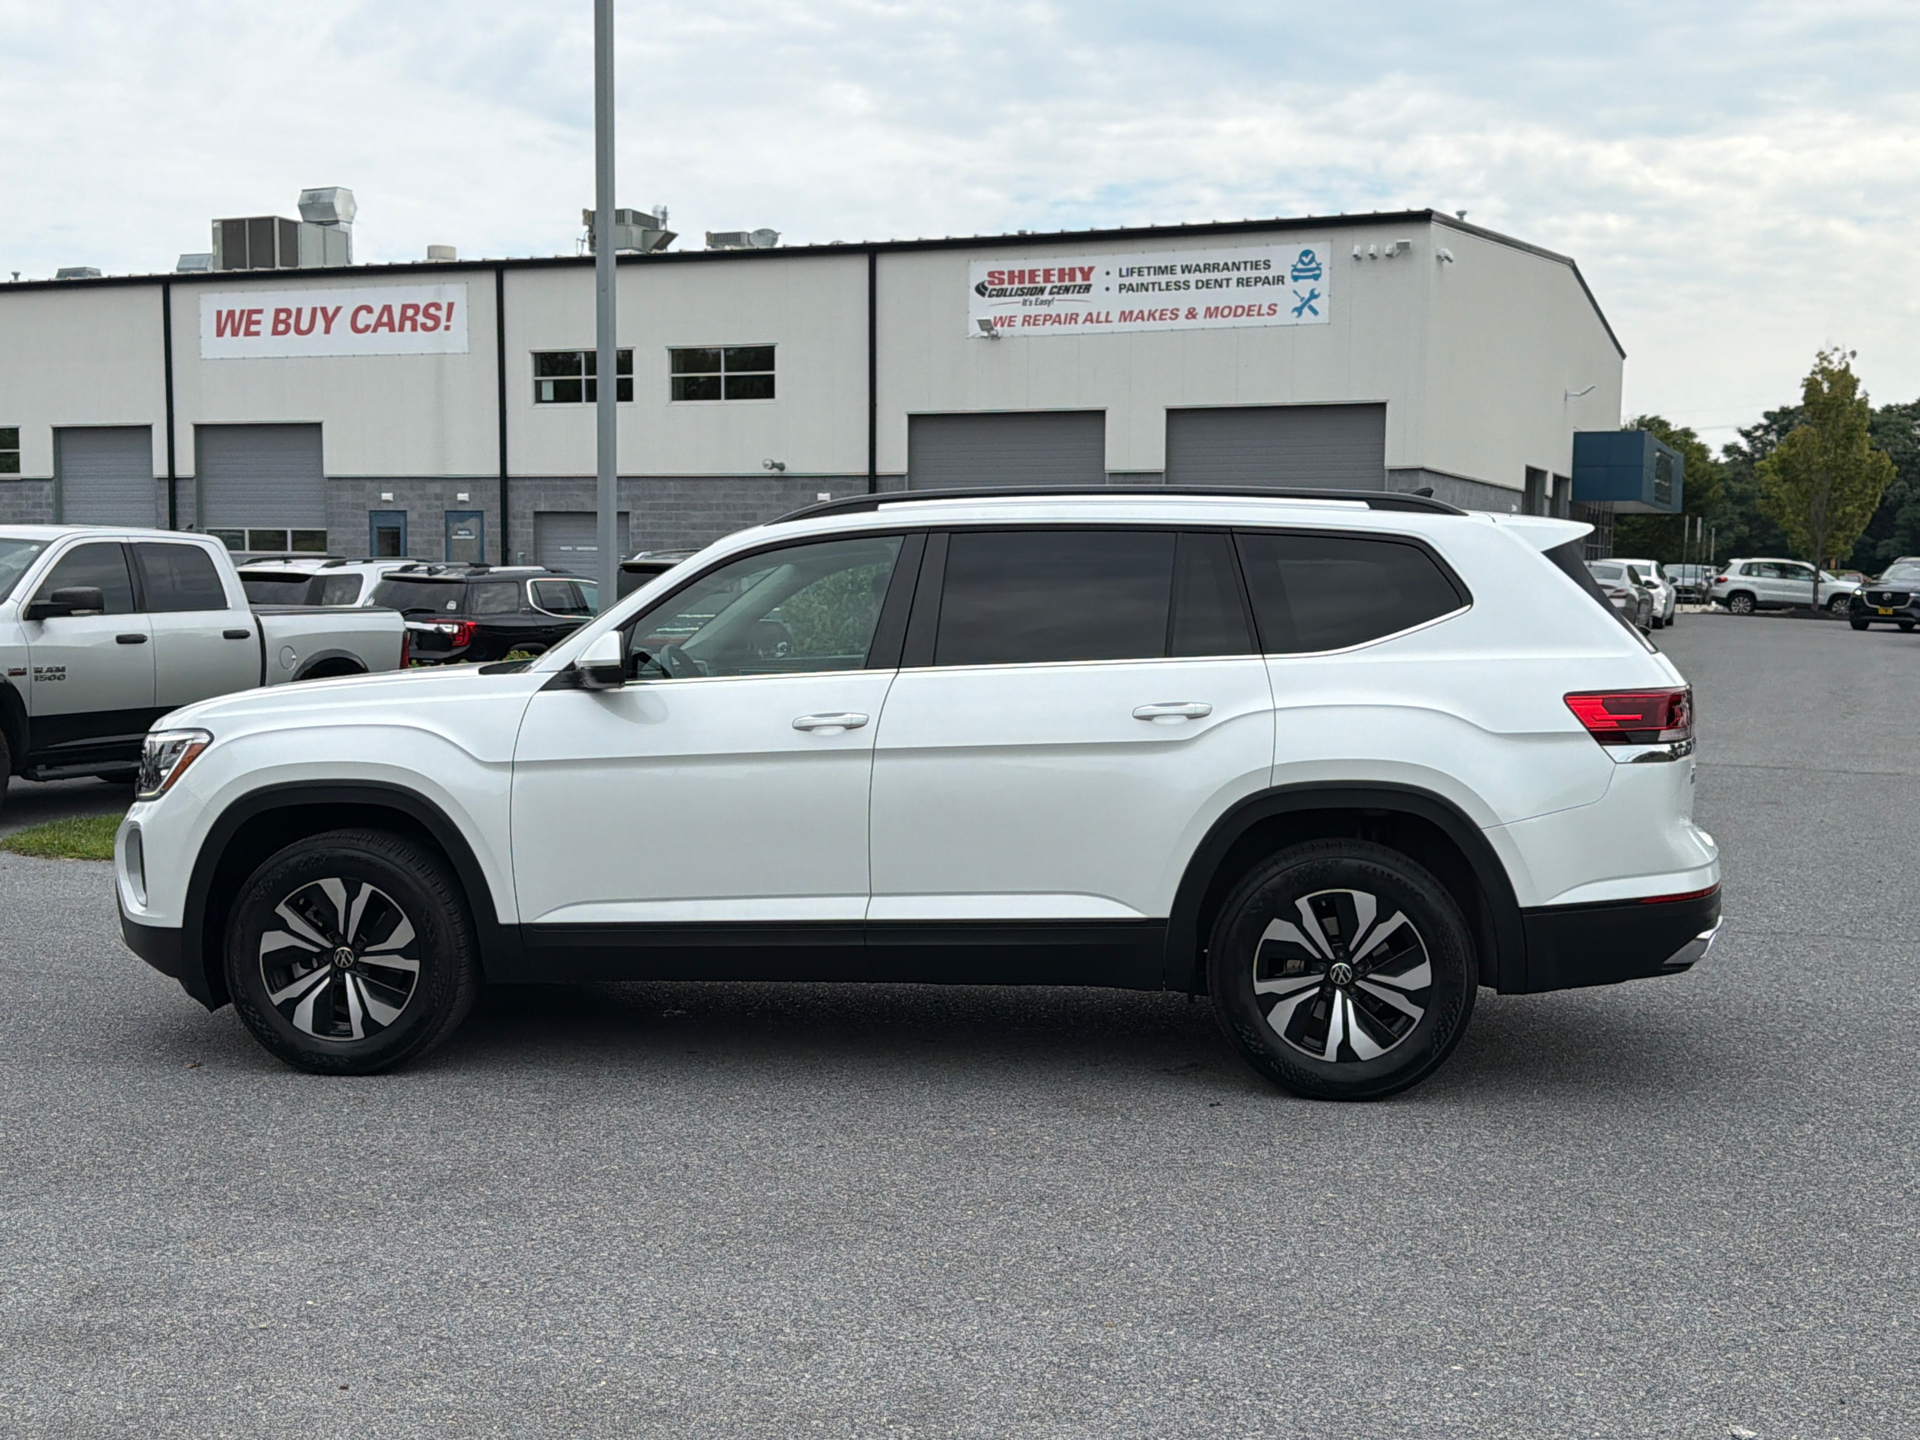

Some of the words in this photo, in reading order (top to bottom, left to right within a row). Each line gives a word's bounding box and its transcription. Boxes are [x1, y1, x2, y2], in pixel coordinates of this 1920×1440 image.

[987, 265, 1095, 286] SHEEHY
[1118, 264, 1177, 278] LIFETIME
[1180, 259, 1272, 275] WARRANTIES
[987, 285, 1047, 298] COLLISION
[1048, 283, 1093, 296] CENTER
[1118, 279, 1191, 293] PAINTLESS
[1195, 277, 1233, 290] DENT
[1236, 274, 1285, 288] REPAIR
[1021, 298, 1033, 307] It's
[1034, 297, 1055, 307] Easy!
[215, 308, 263, 338] WE
[271, 305, 343, 337] BUY
[350, 301, 455, 335] CARS!
[993, 315, 1017, 328] WE
[1021, 312, 1079, 327] REPAIR
[1082, 310, 1113, 325] ALL
[1118, 307, 1180, 323] MAKES
[1184, 306, 1198, 320] &
[1203, 302, 1278, 319] MODELS
[33, 673, 66, 682] 1500
